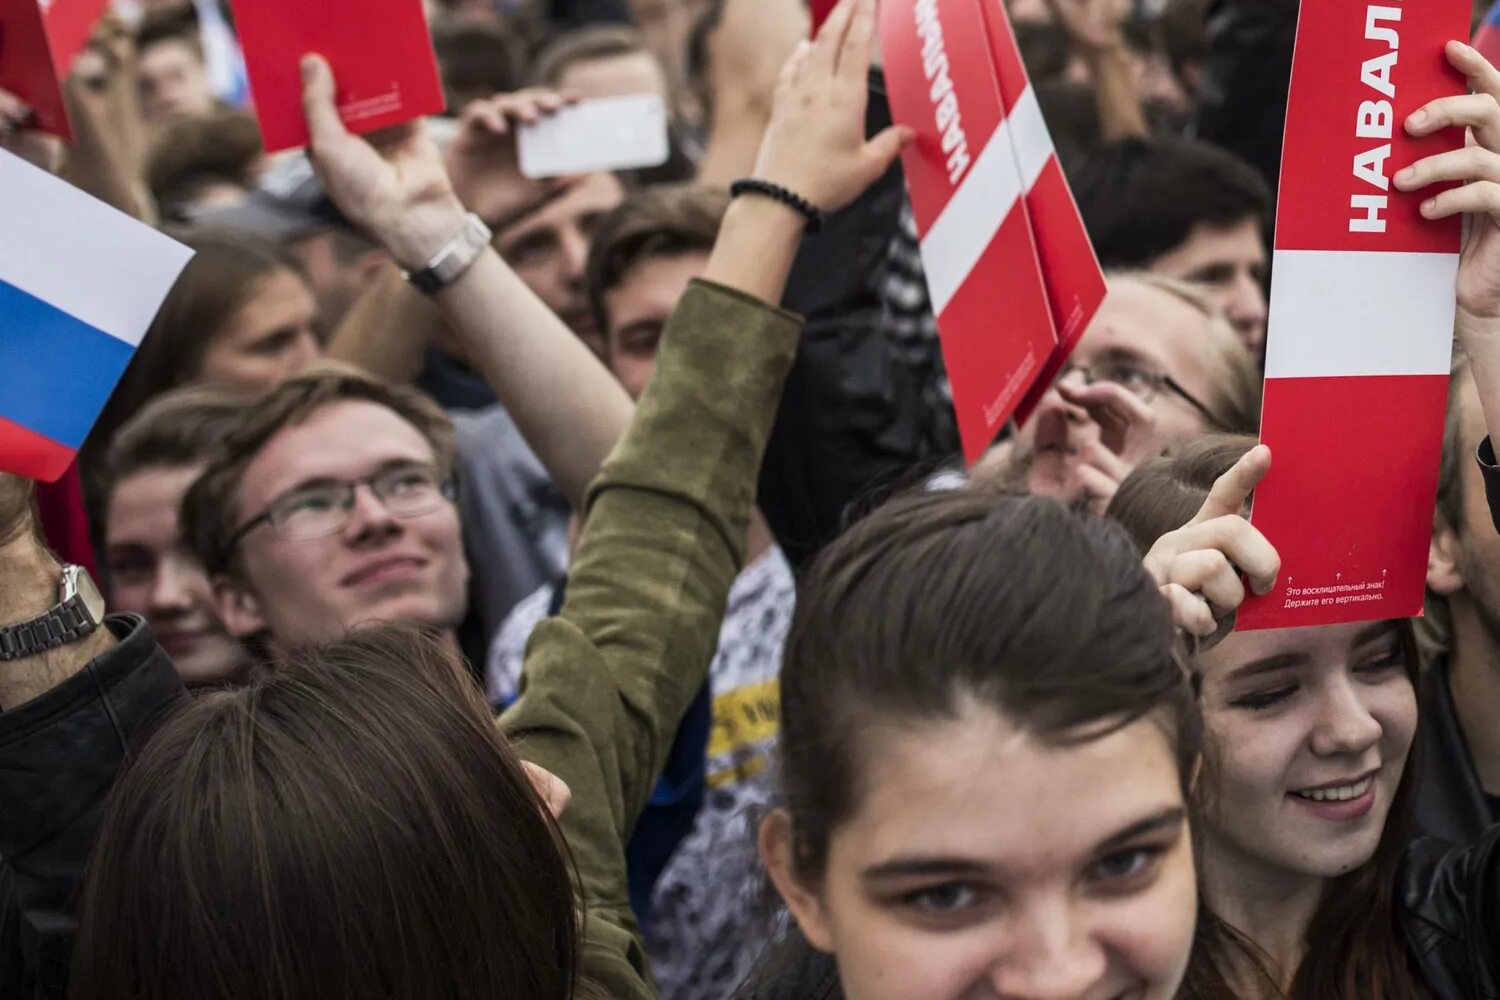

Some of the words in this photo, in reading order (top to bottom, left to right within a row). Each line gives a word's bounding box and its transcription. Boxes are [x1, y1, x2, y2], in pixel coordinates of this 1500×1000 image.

[1286, 587, 1301, 596] Это
[1302, 581, 1365, 595] восклицательный
[1284, 599, 1319, 608] Держите
